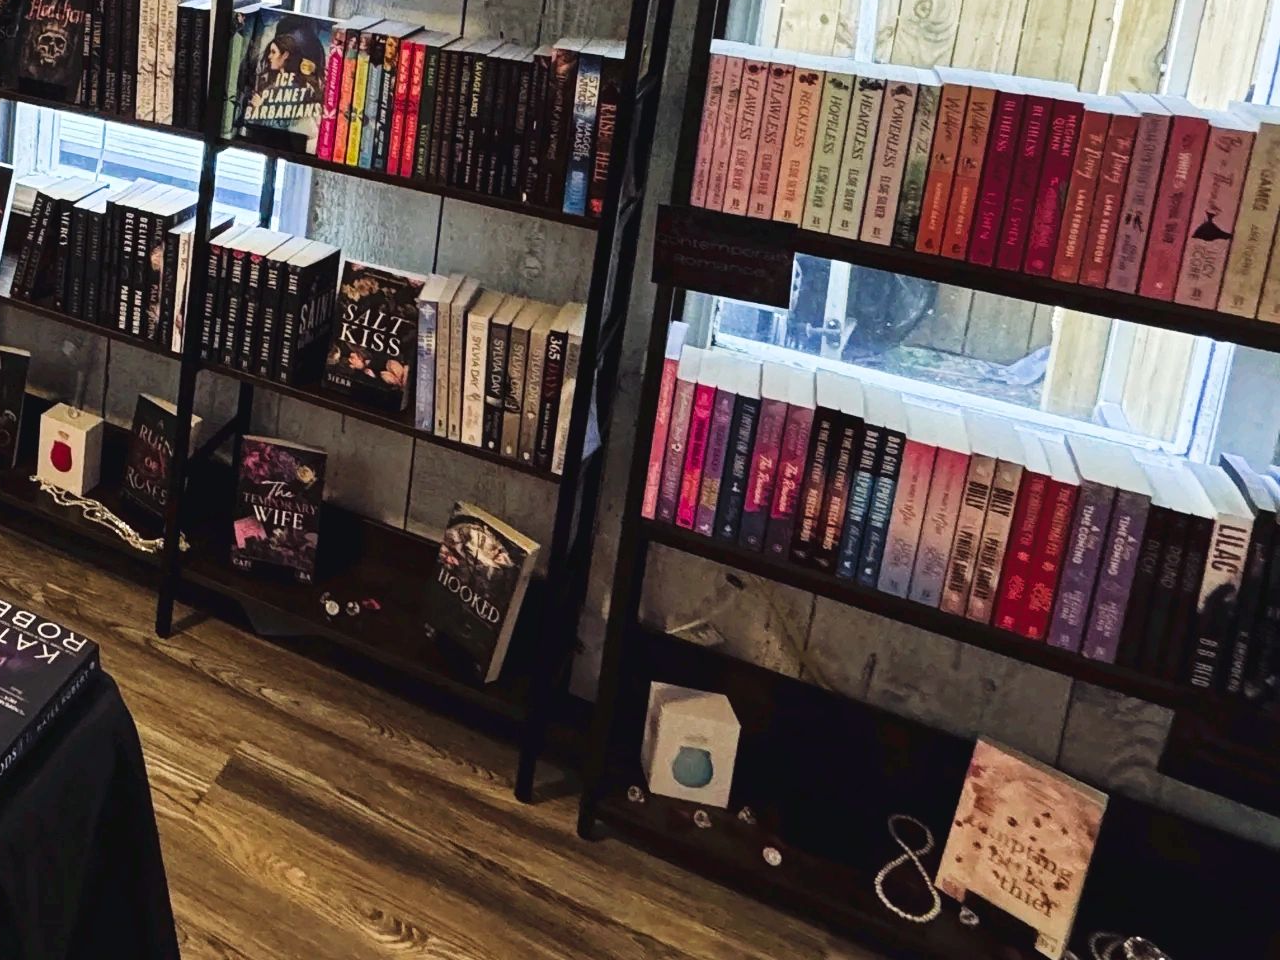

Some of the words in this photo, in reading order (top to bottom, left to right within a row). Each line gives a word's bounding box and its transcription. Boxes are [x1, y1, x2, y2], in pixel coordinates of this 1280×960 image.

[275, 72, 295, 87] ICE
[472, 60, 484, 92] SAVAGE
[260, 87, 307, 103] PLANET
[740, 76, 760, 140] FLAWLESS
[244, 102, 321, 120] BARBARIANS
[597, 103, 617, 137] RAISE
[764, 80, 785, 144] FLAWLESS
[794, 88, 813, 148] RECKLESS
[822, 94, 843, 155] HOPELESS
[580, 122, 592, 158] MAGGIE
[851, 93, 874, 160] HEARTLESS
[883, 98, 905, 168] POWERLESS
[593, 151, 610, 183] HELL
[123, 212, 135, 253] DELIVER
[137, 216, 148, 257] DELIVER
[1066, 214, 1082, 258] FERGUSON
[231, 260, 243, 283] SINNER
[249, 263, 260, 288] SINNER
[267, 268, 278, 290] SAINT
[288, 274, 299, 295] SAINT
[120, 285, 128, 301] PAM
[134, 290, 142, 306] PAM
[118, 302, 128, 329] GODWIN
[132, 307, 141, 334] GODWIN
[343, 303, 416, 335] SALT
[339, 322, 401, 357] KISS
[469, 335, 481, 367] SYLVIA
[548, 335, 563, 360] 365
[493, 339, 504, 373] SYLVIA
[469, 367, 480, 389] DAY
[491, 375, 500, 399] DAY
[138, 424, 175, 458] RUIN
[863, 430, 879, 449] BAD
[884, 436, 900, 455] BAD
[860, 450, 875, 471] GIRL
[881, 455, 897, 477] GIRL
[125, 471, 168, 507] ROSES
[242, 492, 319, 516] TEMPORARY
[261, 480, 297, 500] The
[849, 470, 872, 522] REPUTATION
[870, 476, 893, 528] REPUTATION
[965, 481, 989, 511] BULLY
[989, 487, 1014, 517] BULLY
[253, 504, 306, 531] WIFE
[1081, 505, 1094, 526] TIME
[1118, 515, 1131, 537] TIME
[1072, 526, 1089, 564] COMING
[1108, 537, 1124, 576] COMING
[1212, 524, 1247, 574] LILAC
[437, 568, 501, 625] HOOKED
[1191, 662, 1214, 688] REID
